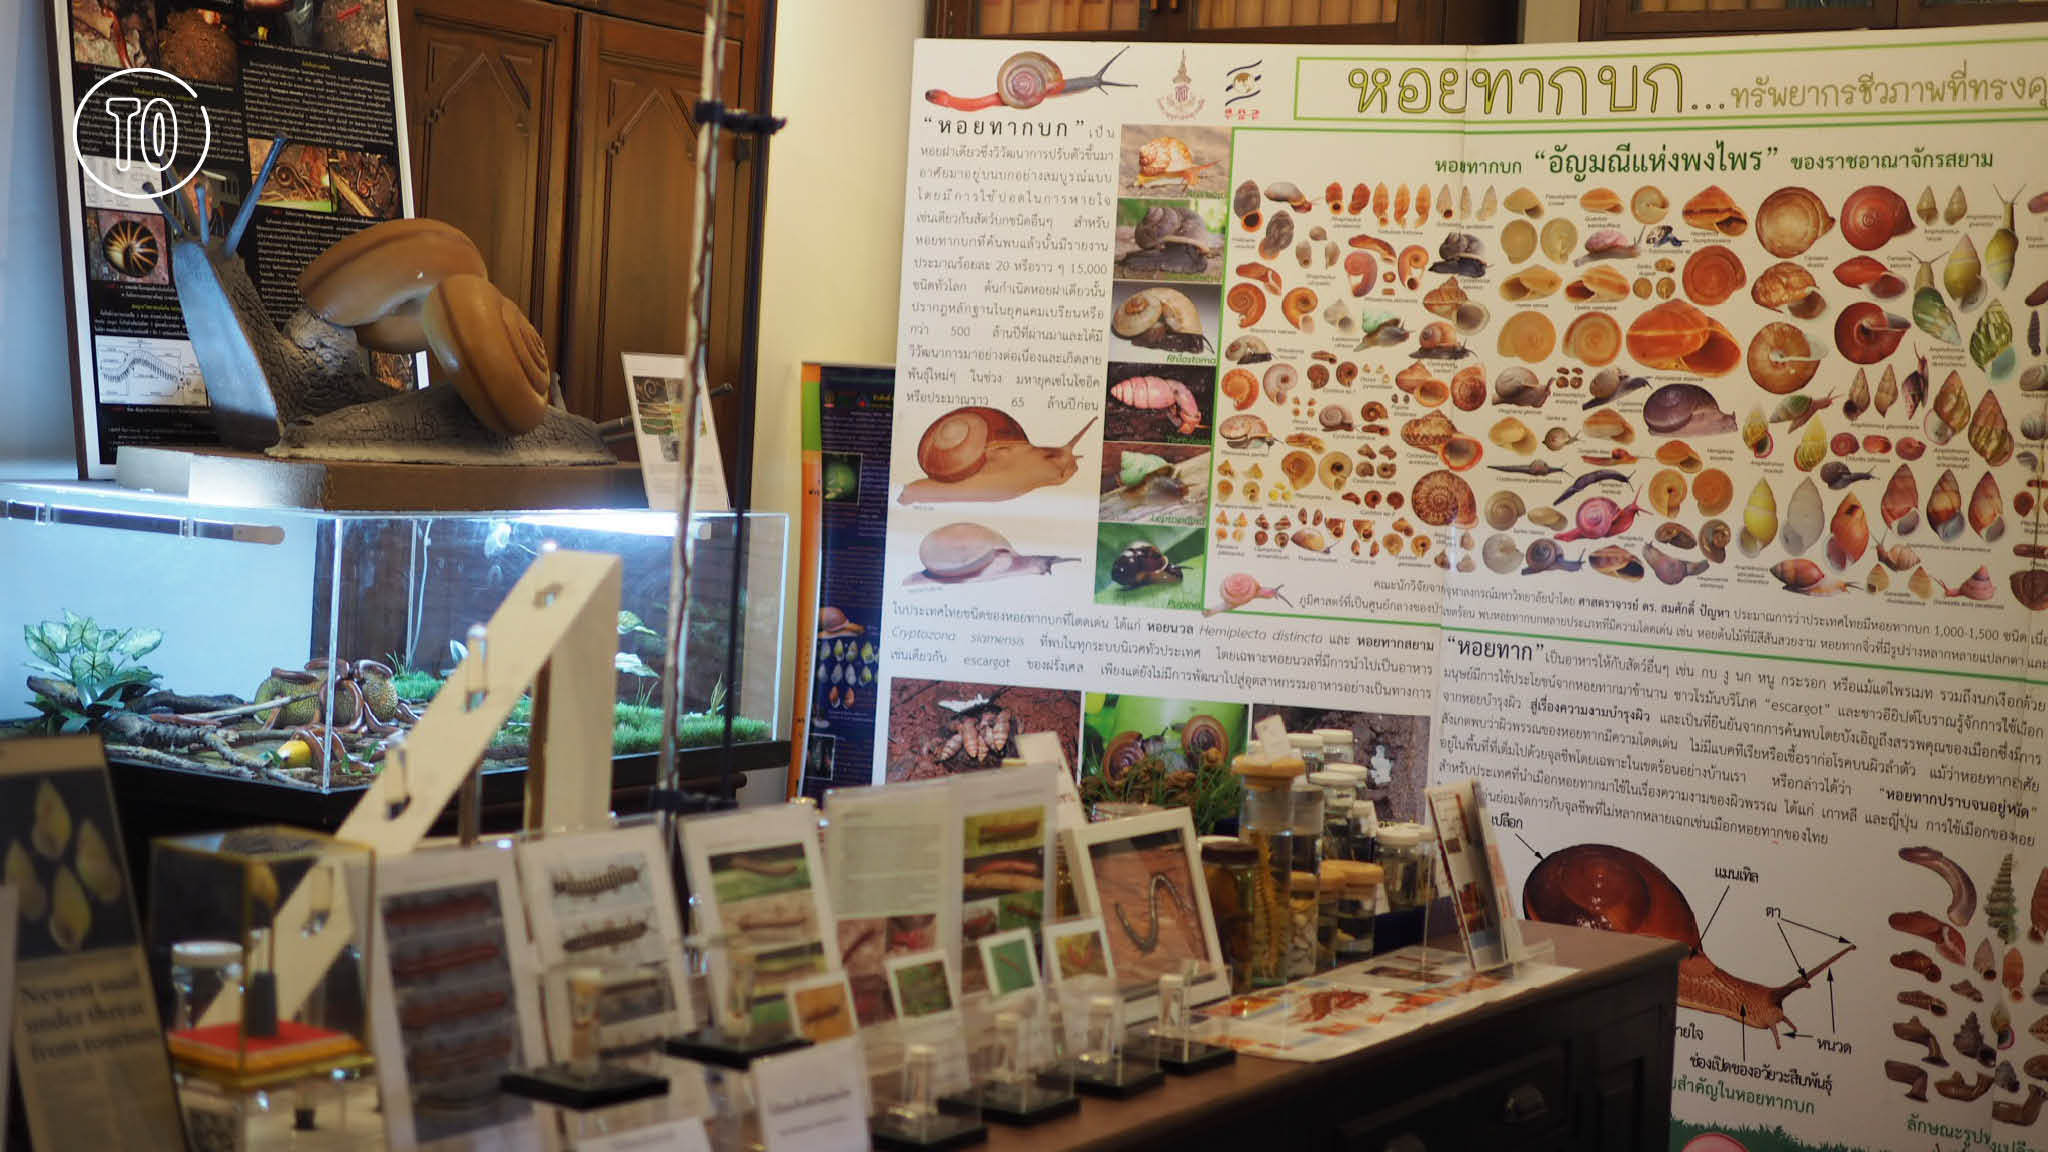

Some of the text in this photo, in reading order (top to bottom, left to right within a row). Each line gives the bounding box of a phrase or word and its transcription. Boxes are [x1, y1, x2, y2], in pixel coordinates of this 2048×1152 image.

[1535, 140, 1779, 182] “อัญมณีแห่งพงไพร”
[1790, 146, 1994, 170] ของราชอาณาจักรสยาม
[995, 260, 1010, 271] 20
[951, 326, 971, 337] 500
[1011, 397, 1025, 408] 65
[1447, 635, 1544, 661] “หอยทาก”
[1491, 811, 1523, 830] เปลือก
[1715, 862, 1759, 885] แมนเทิล
[1765, 905, 1782, 920] ตา
[1675, 1022, 1704, 1041] ายใจ
[1816, 1034, 1853, 1056] หนวด
